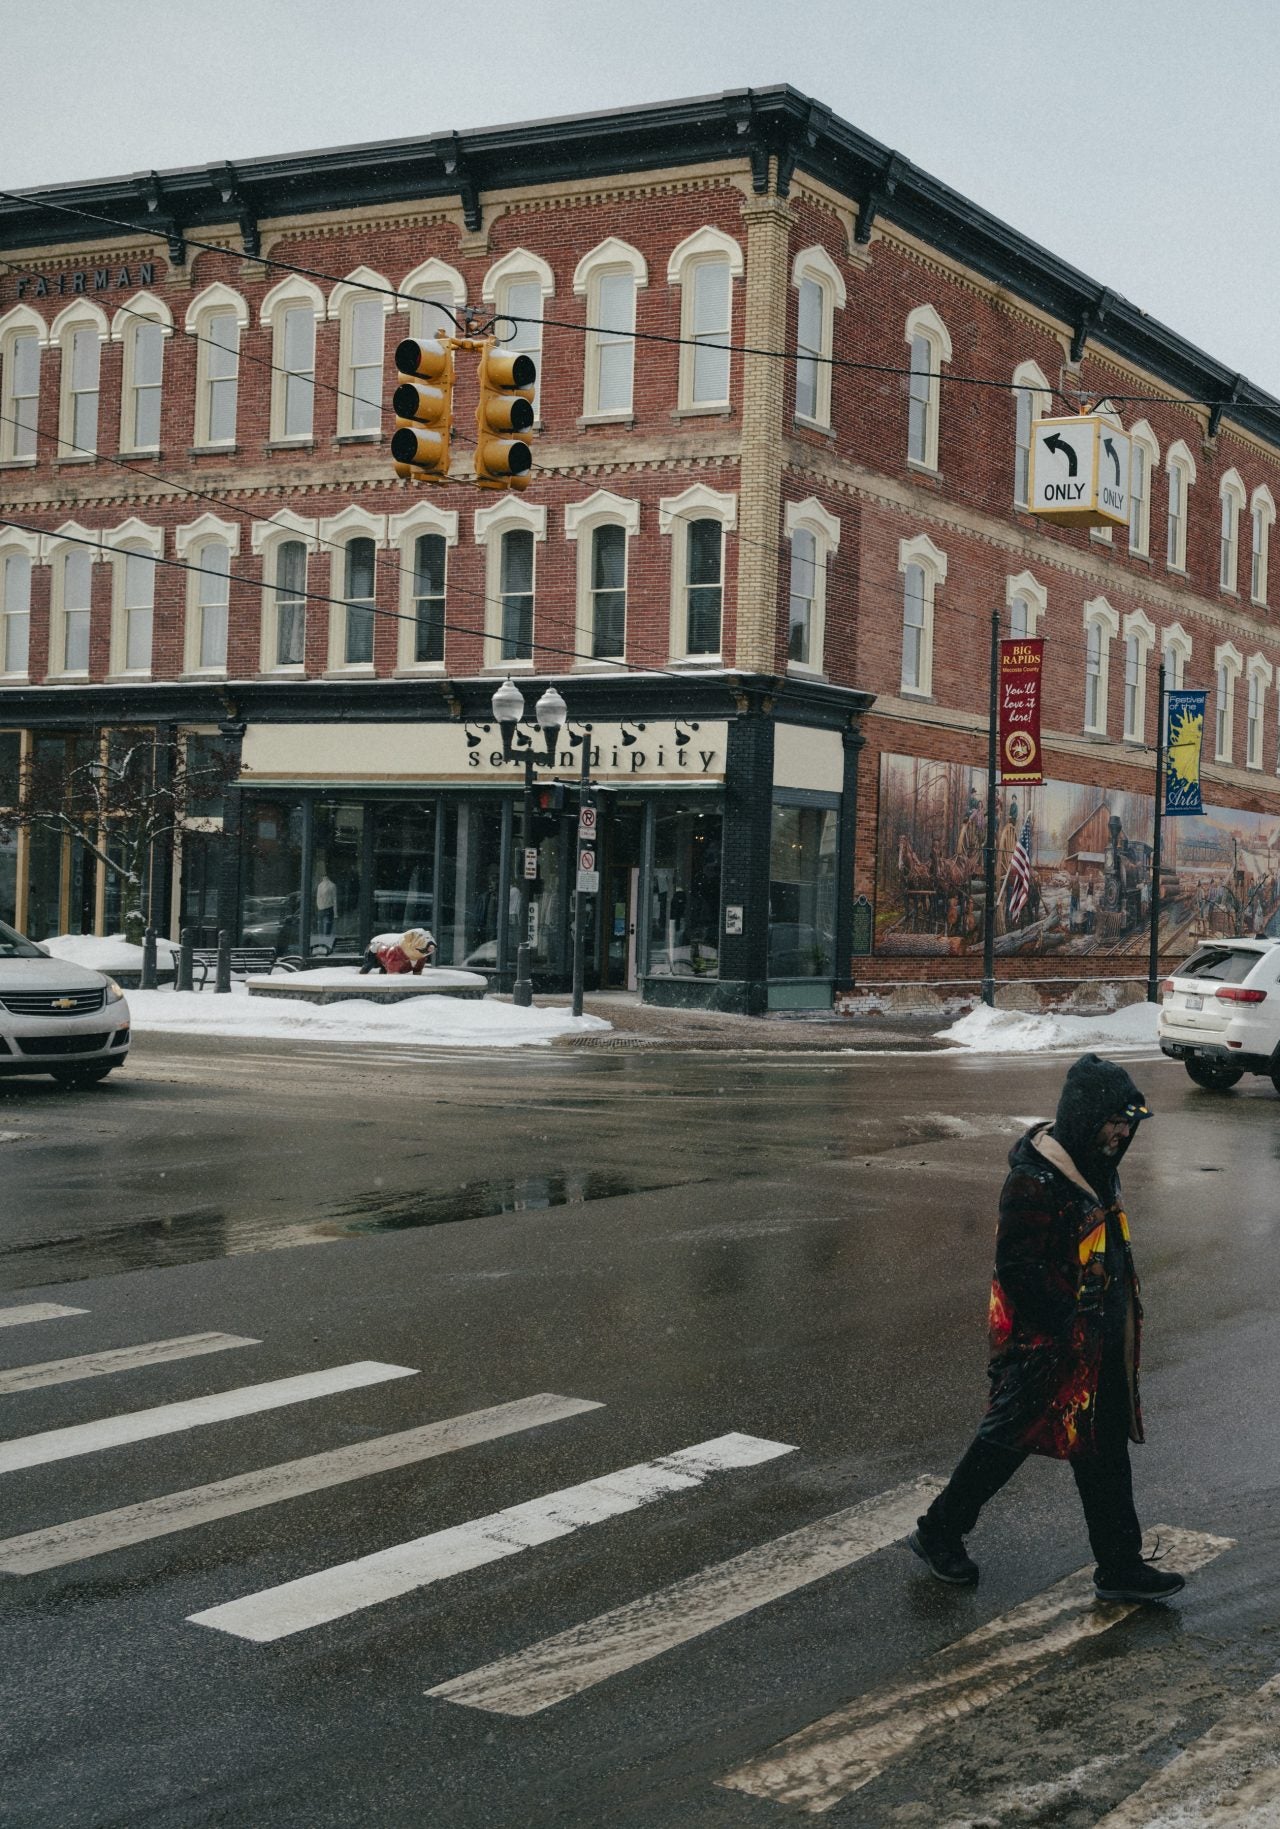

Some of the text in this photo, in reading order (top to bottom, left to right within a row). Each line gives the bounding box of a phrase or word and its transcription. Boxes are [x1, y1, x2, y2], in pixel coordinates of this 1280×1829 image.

[16, 263, 153, 298] FAIRMAN
[1044, 483, 1086, 501] ONLY
[1103, 487, 1124, 510] ONLY
[1013, 646, 1032, 655] BIG
[1003, 655, 1041, 664] RAPIDS
[1005, 682, 1035, 696] You'll
[1003, 697, 1024, 709] love
[1170, 695, 1204, 703] Festival
[468, 745, 716, 773] sendipity
